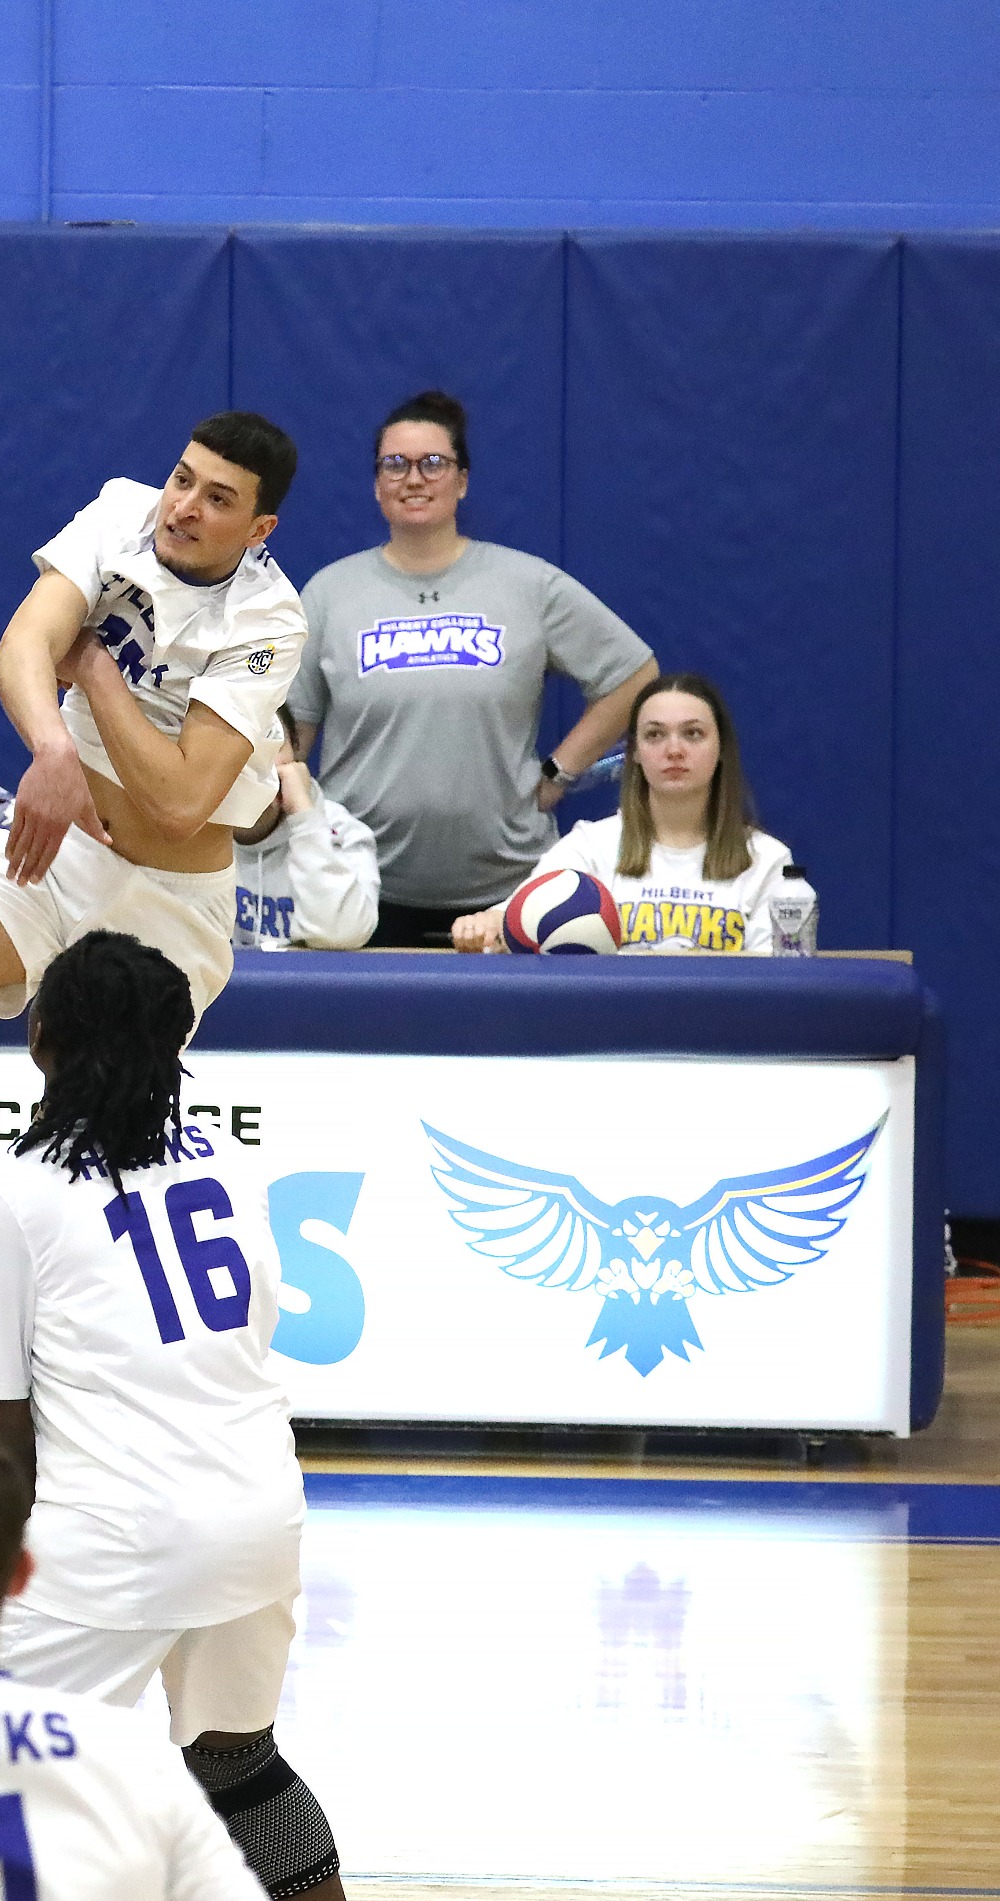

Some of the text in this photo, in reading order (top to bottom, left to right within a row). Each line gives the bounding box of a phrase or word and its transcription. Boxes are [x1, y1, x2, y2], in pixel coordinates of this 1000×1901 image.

[363, 627, 500, 667] HAWKS
[640, 886, 714, 902] HILBERT
[103, 1177, 251, 1345] 16
